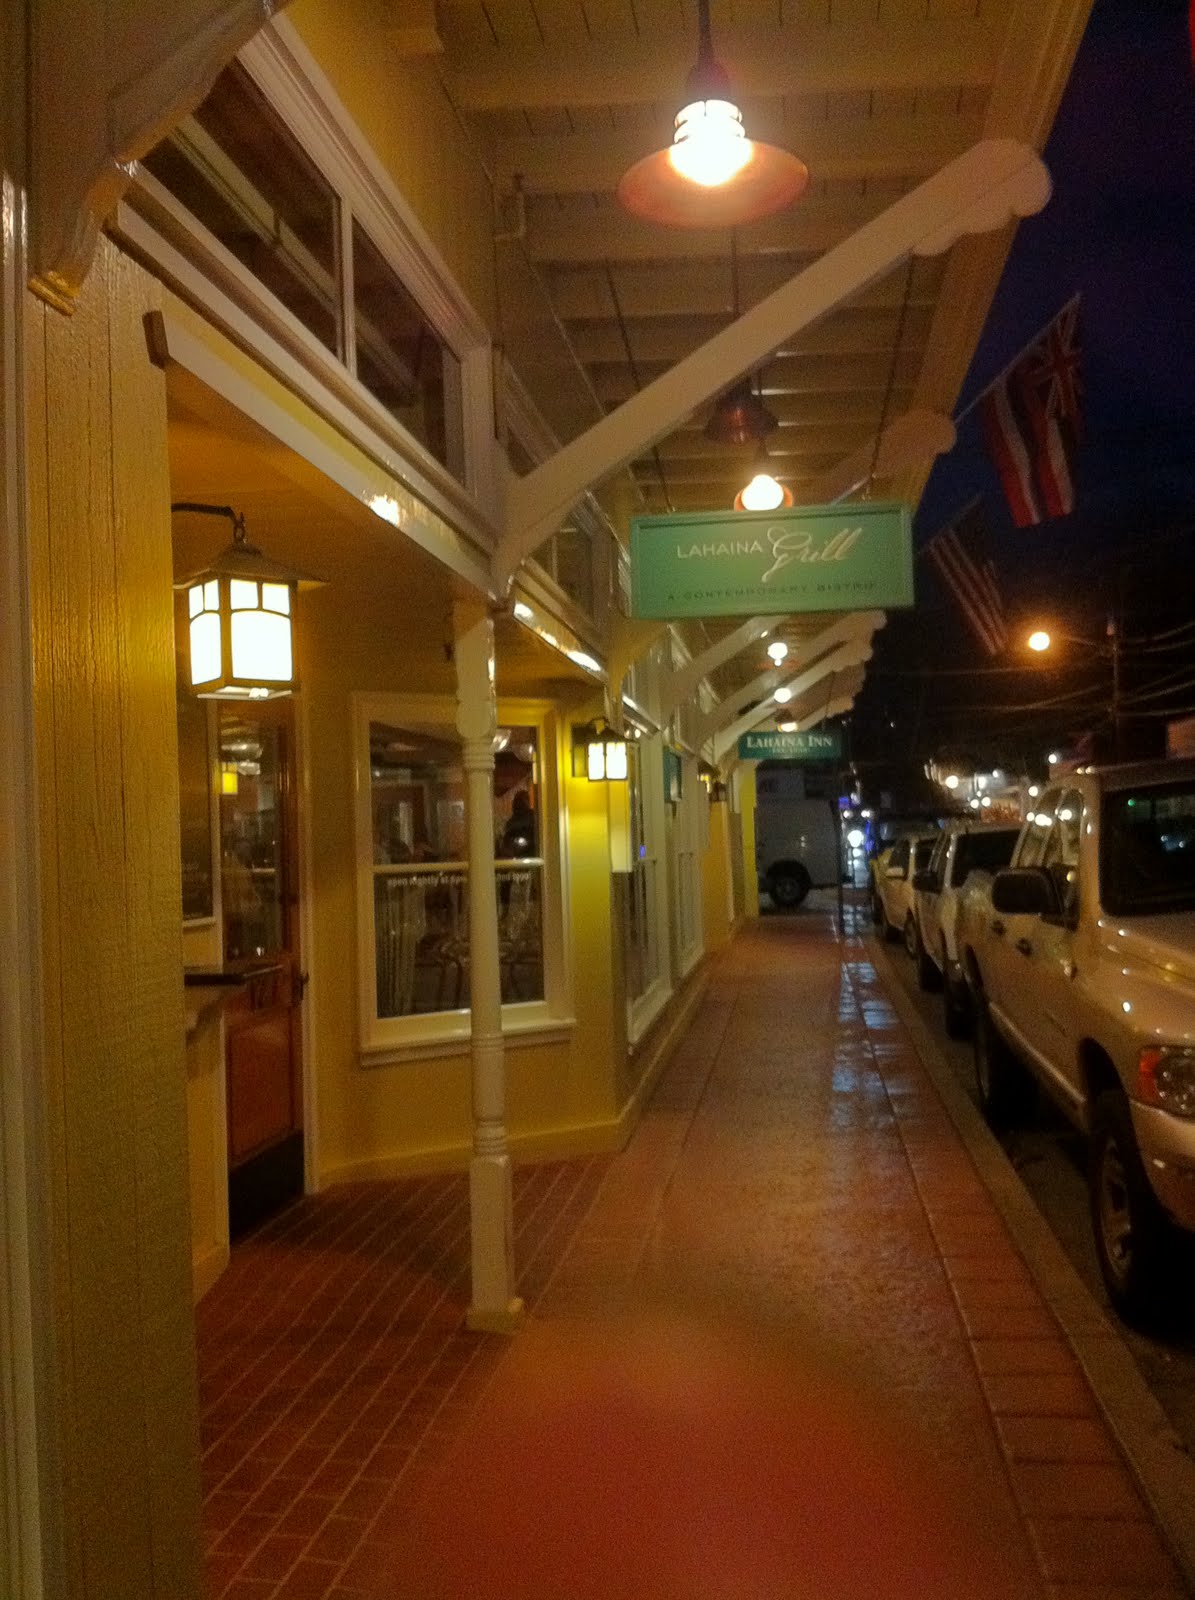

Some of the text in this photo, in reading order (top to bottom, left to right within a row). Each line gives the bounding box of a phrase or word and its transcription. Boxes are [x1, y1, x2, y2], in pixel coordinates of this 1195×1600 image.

[677, 527, 863, 583] LAHAINA Grill
[747, 735, 832, 748] LAHAINA INN
